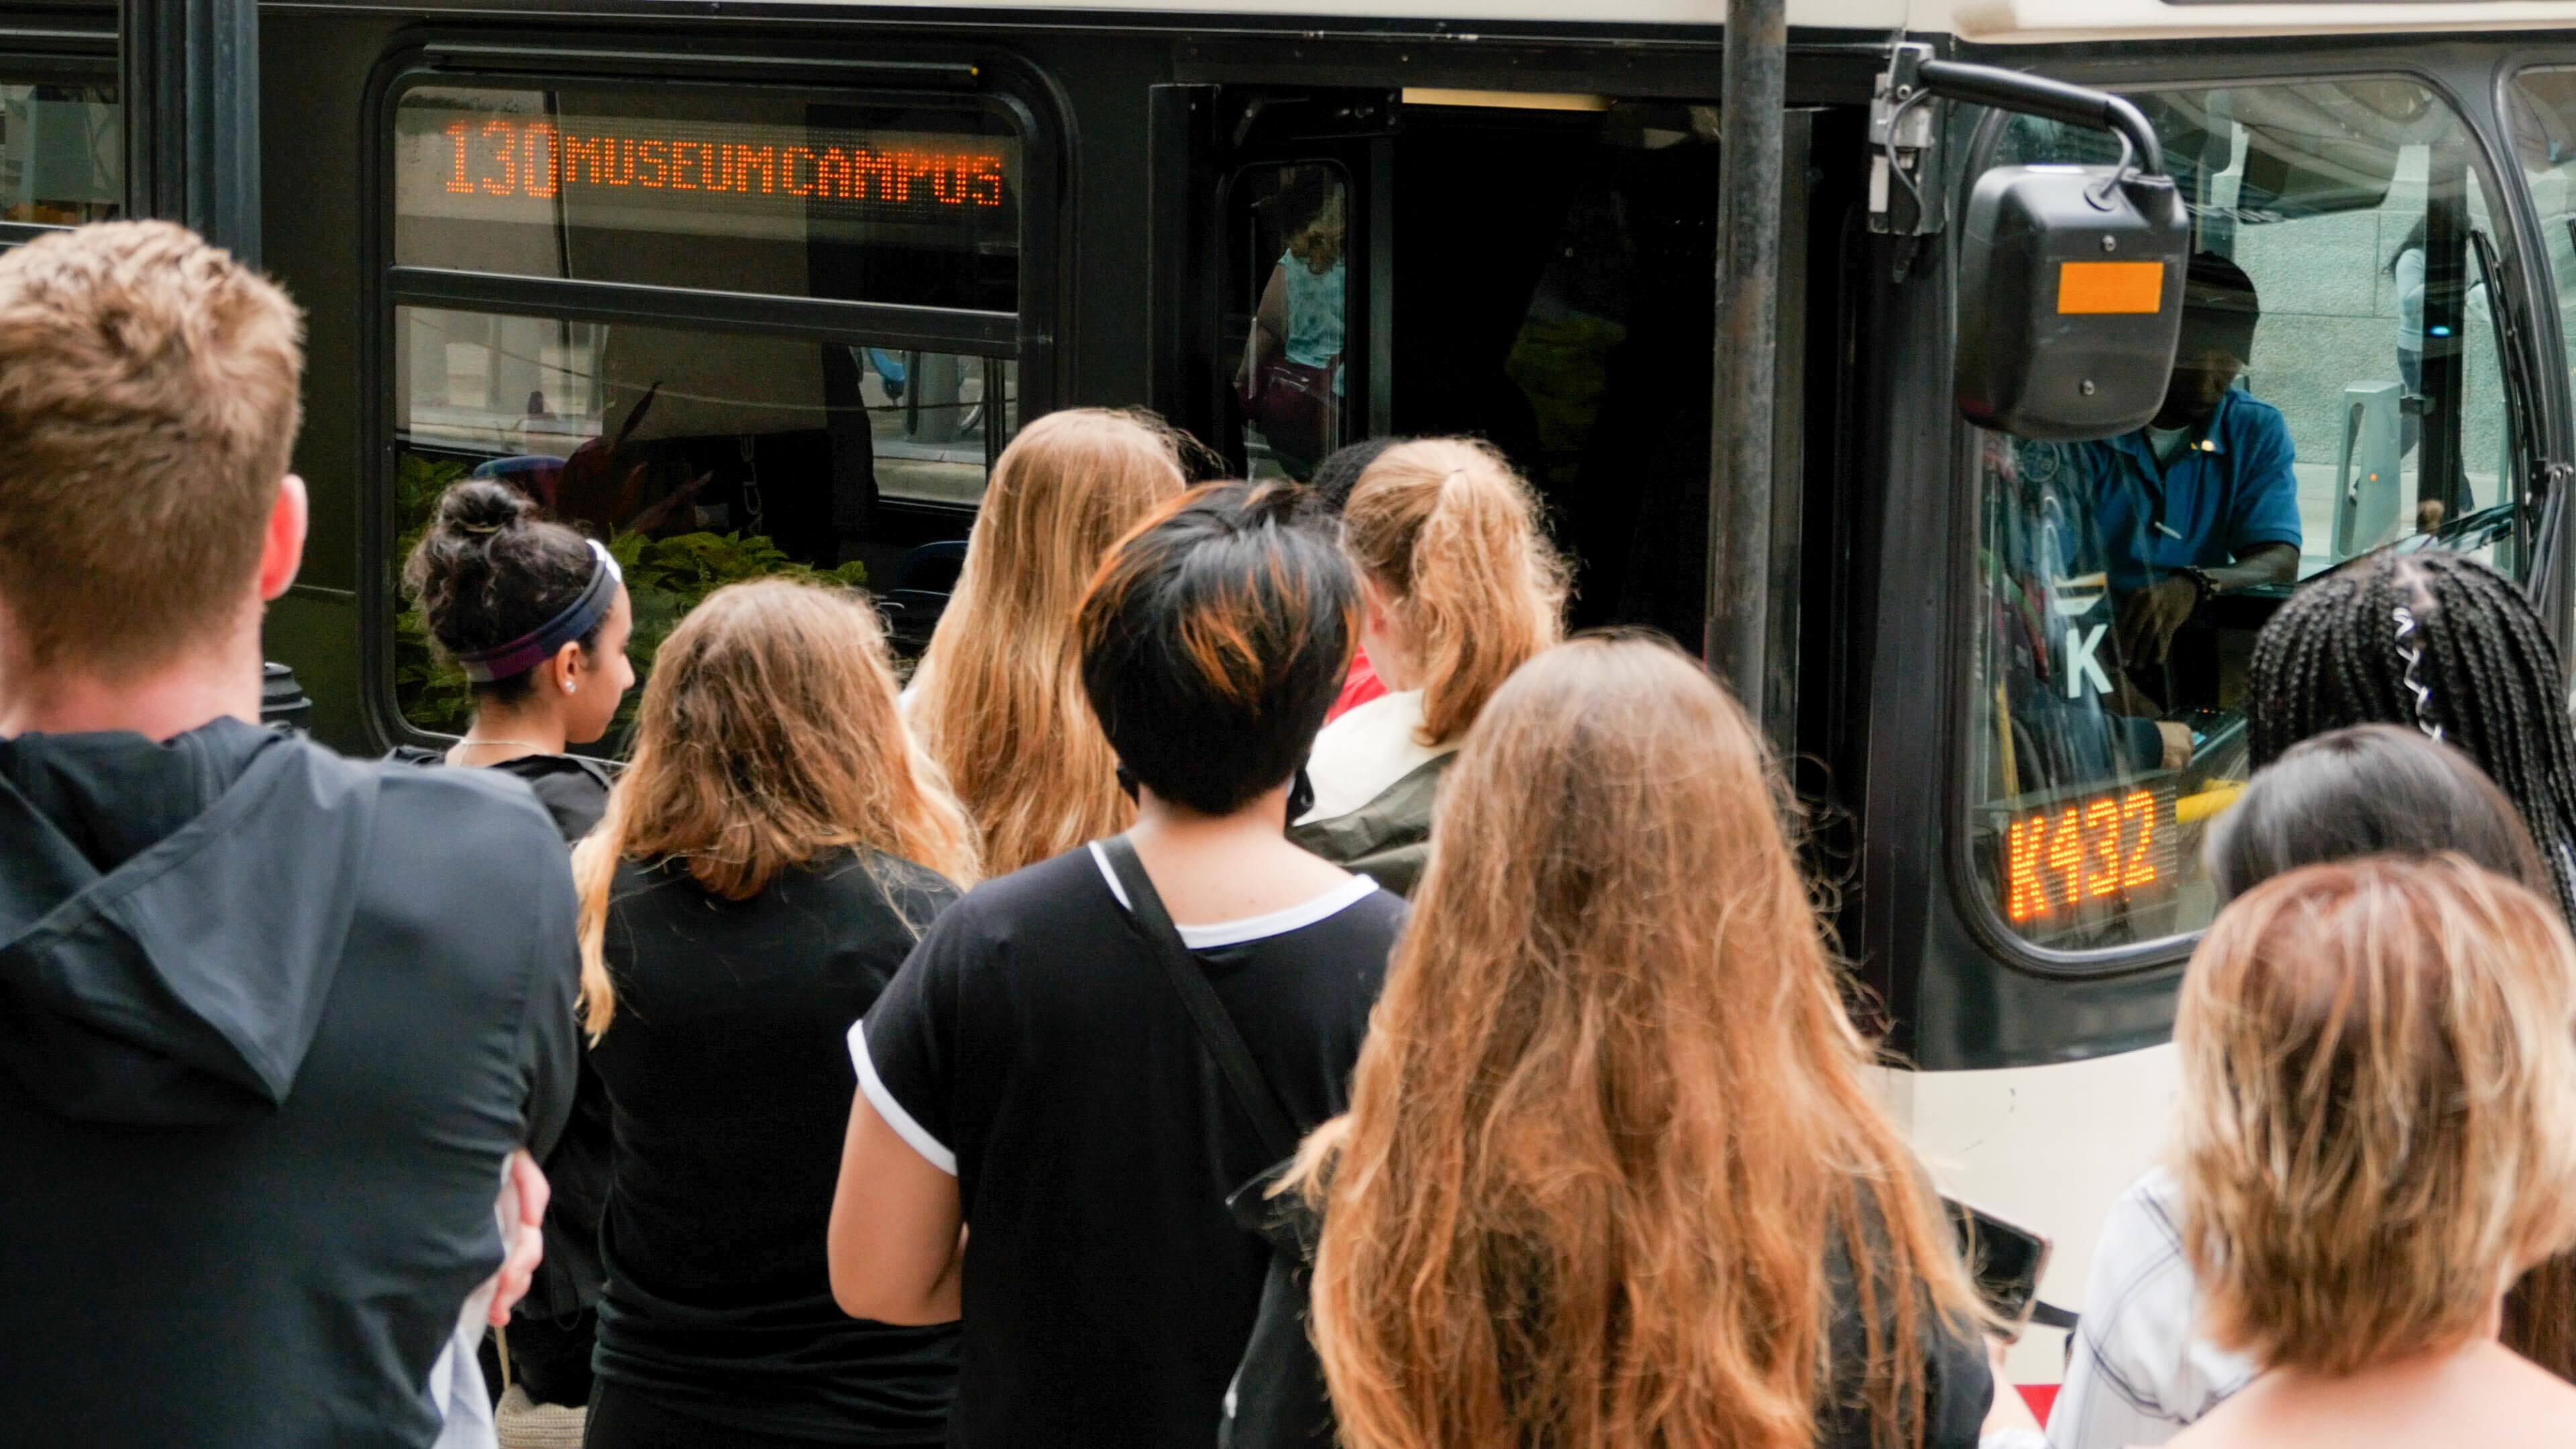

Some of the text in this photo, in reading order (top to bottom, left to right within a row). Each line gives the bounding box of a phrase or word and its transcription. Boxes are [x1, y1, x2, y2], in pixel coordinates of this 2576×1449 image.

[445, 119, 1002, 205] 130 MUSEUM CAMPUS
[2066, 623, 2114, 698] K
[2010, 790, 2155, 920] K432
